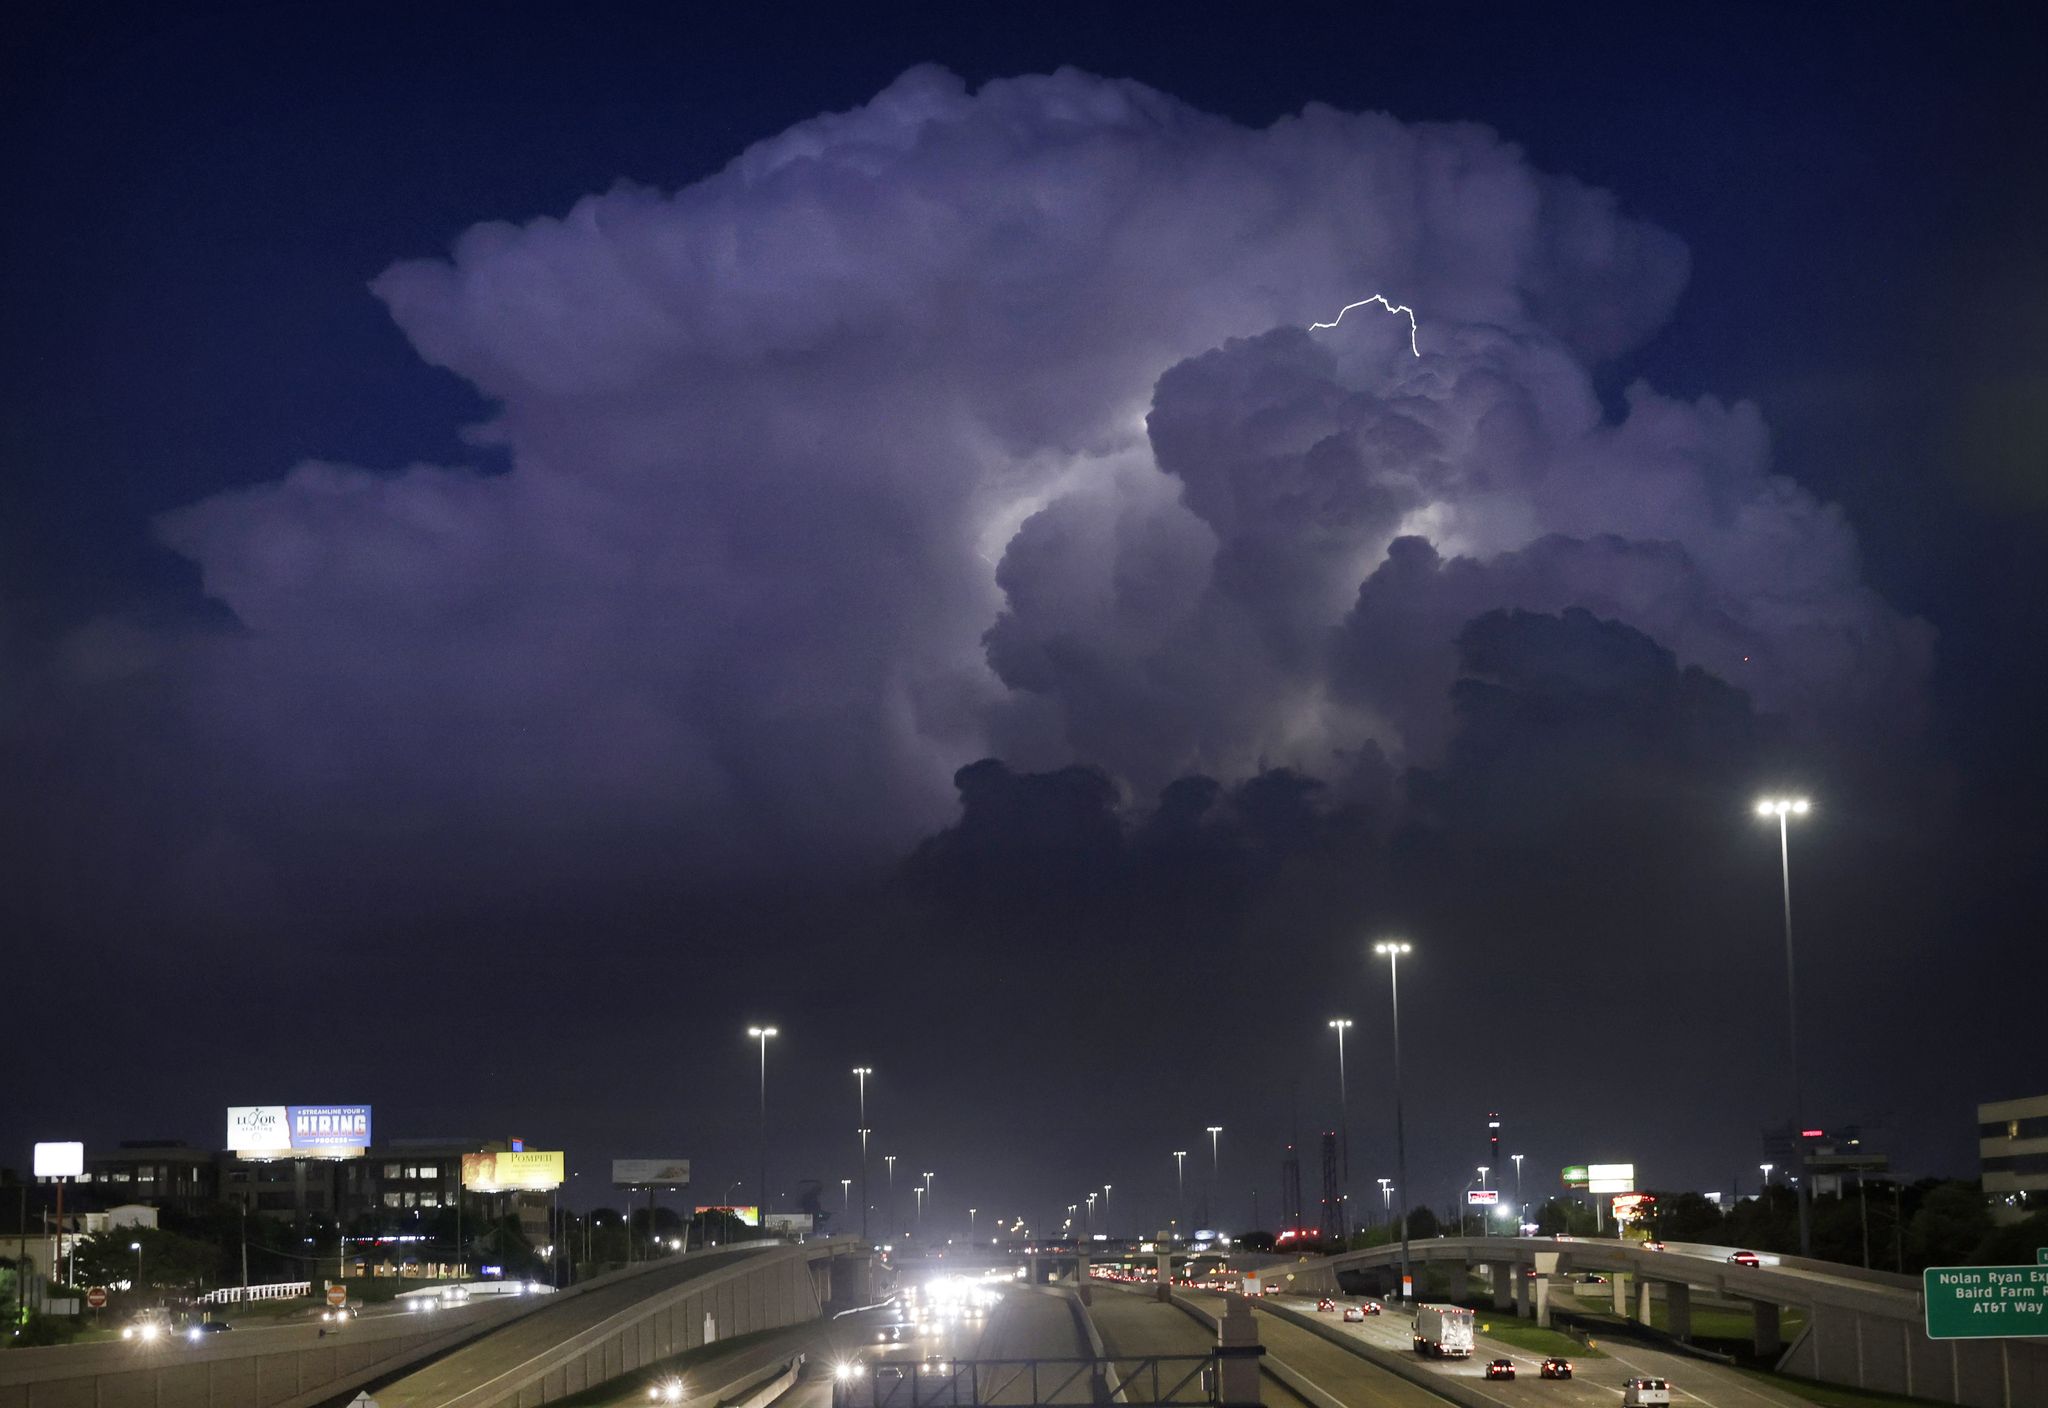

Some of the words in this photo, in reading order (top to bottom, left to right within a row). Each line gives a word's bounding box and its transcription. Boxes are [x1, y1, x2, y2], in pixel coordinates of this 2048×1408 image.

[297, 1114, 367, 1137] HIRING
[1940, 1273, 1980, 1284] Nolan
[1988, 1272, 2022, 1285] Ryan
[1956, 1287, 1992, 1298] Baird
[2000, 1287, 2034, 1297] Farm
[1973, 1302, 2007, 1313] AT&T
[2014, 1302, 2043, 1314] Way
